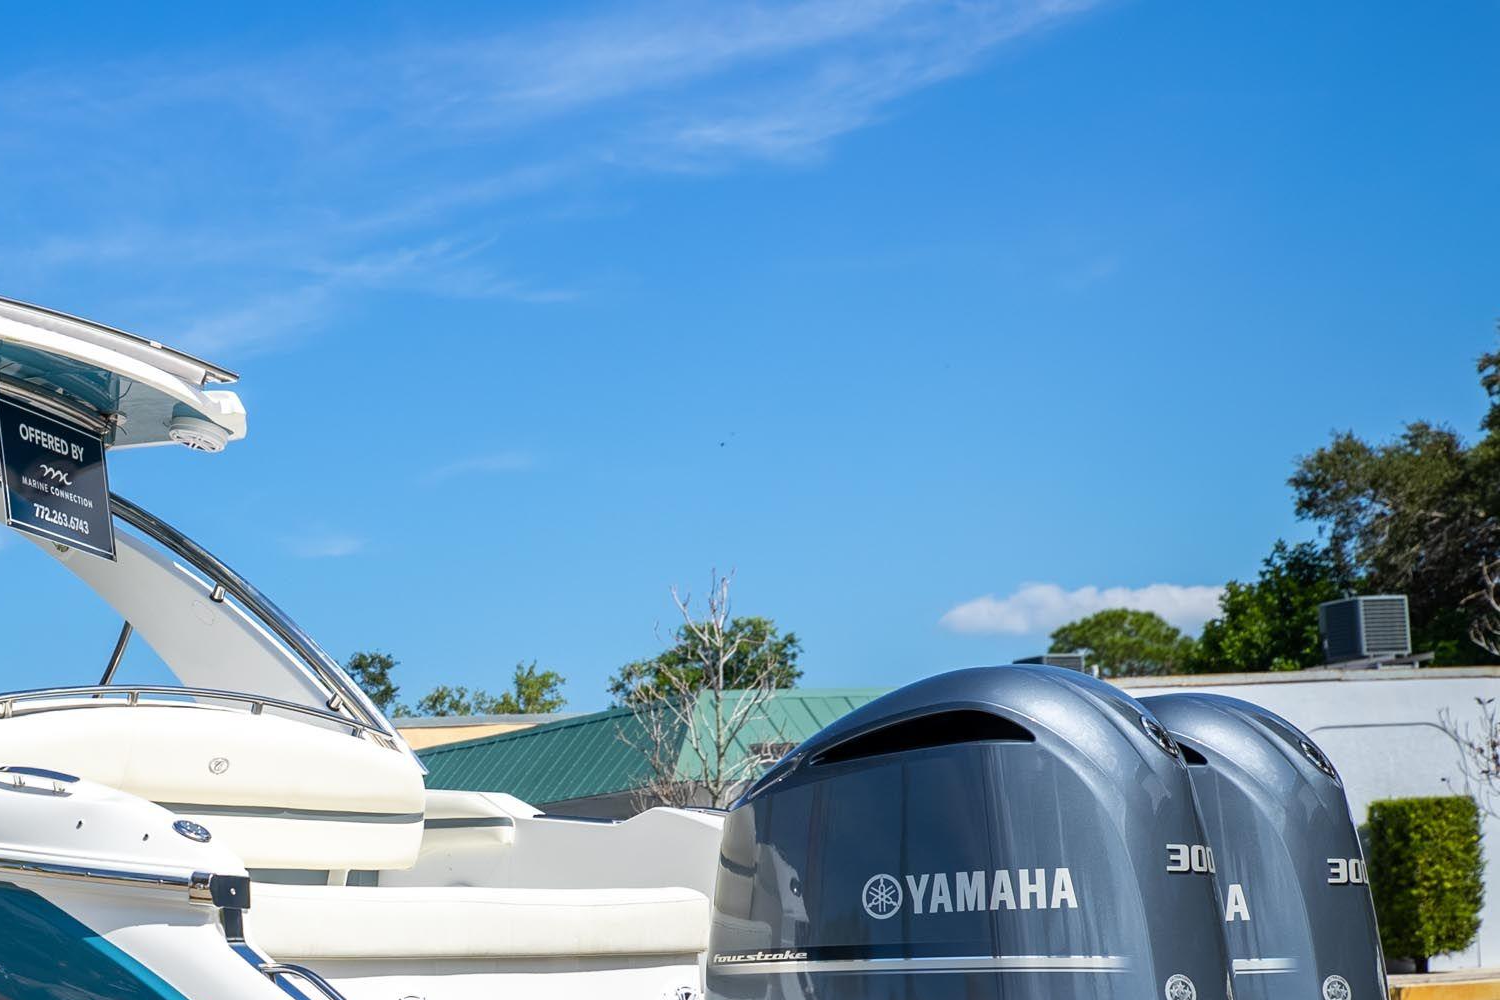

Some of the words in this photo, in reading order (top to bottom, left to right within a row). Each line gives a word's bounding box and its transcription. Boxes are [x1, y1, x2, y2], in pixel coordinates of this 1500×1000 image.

[19, 423, 69, 455] OFFERED
[70, 443, 84, 462] BY
[21, 475, 49, 493] MARINE
[50, 486, 93, 509] CONNECTION
[33, 502, 90, 535] 772.263.6743
[1165, 843, 1216, 874] 300
[905, 867, 1078, 914] YAMAHA
